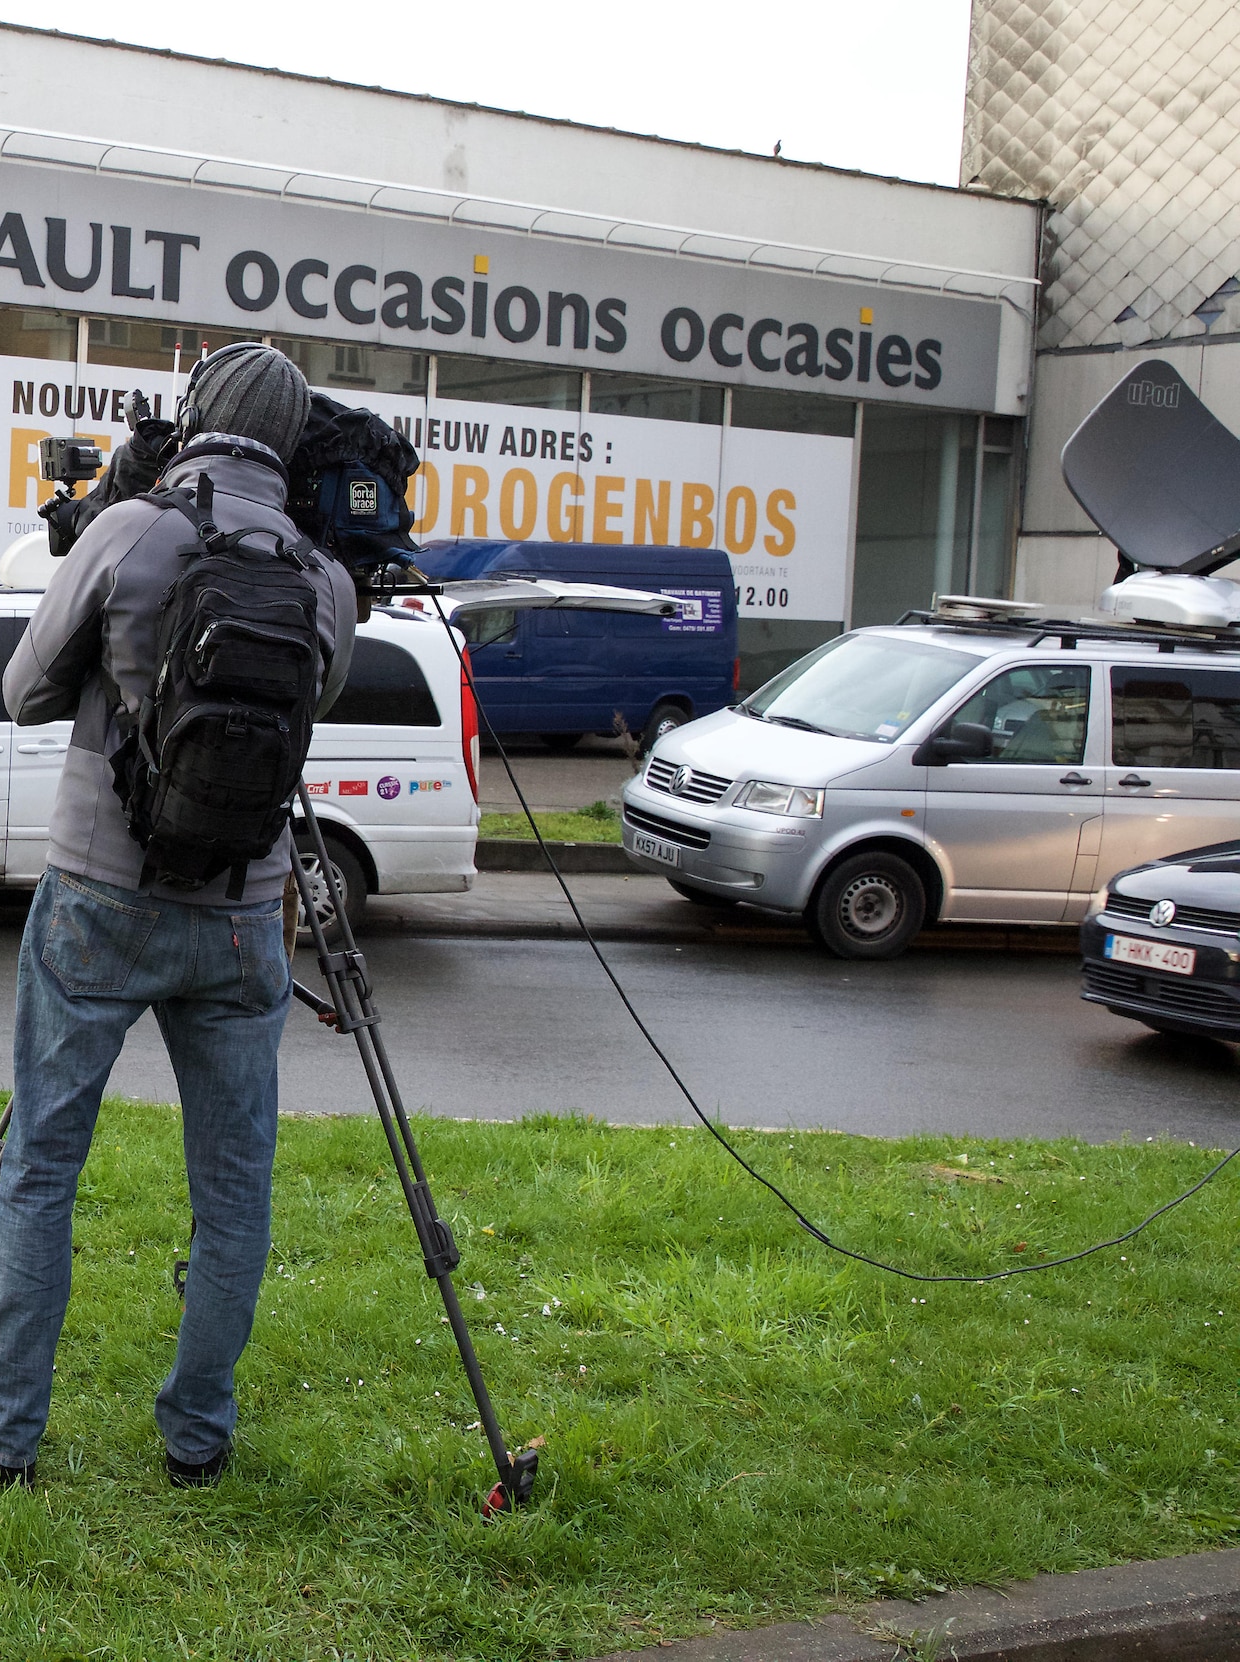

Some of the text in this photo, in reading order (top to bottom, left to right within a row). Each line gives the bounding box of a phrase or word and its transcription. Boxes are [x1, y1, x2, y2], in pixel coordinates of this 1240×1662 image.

[225, 250, 628, 354] occasions
[661, 306, 943, 391] occasies
[1128, 380, 1181, 408] uPod
[394, 416, 489, 454] NIEUW
[499, 425, 594, 463] ADRES
[352, 489, 374, 499] porta
[352, 499, 374, 508] brace
[404, 461, 797, 557] DROGENBOS
[779, 567, 788, 578] TE
[409, 780, 442, 796] pure
[635, 836, 674, 862] KX57 AJU
[1116, 941, 1190, 968] 1-HKK-400
